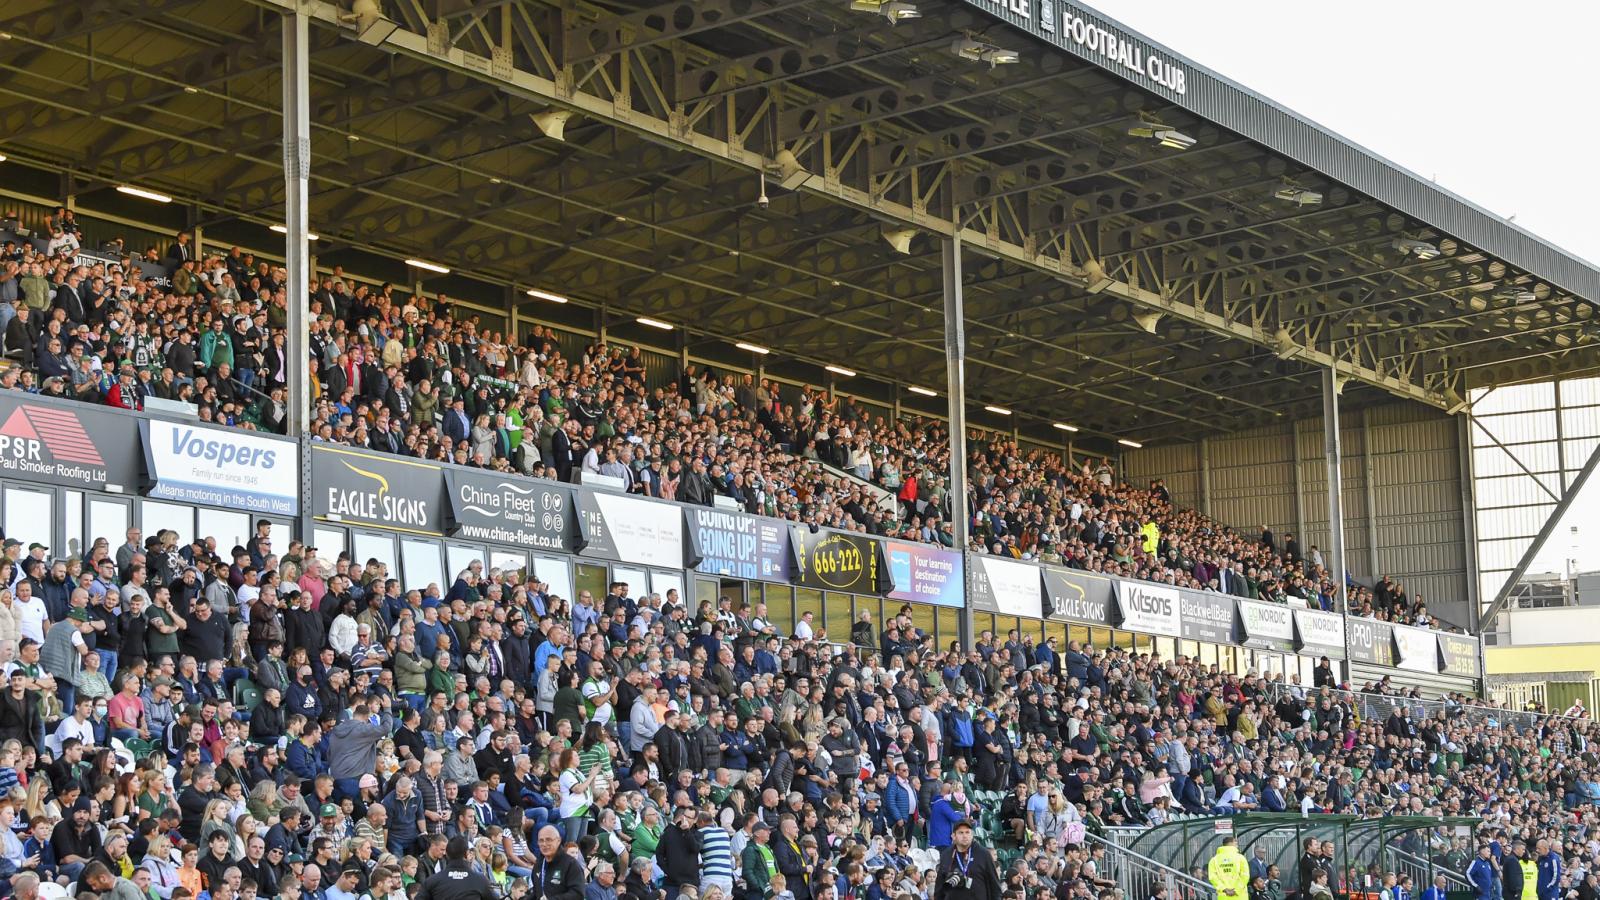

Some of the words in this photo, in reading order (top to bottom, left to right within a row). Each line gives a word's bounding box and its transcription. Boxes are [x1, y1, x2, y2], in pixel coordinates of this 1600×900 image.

[1062, 11, 1145, 76] FOOTBALL
[1147, 55, 1186, 95] CLUB
[0, 434, 41, 461] PSR
[172, 427, 276, 469] Vospers
[20, 459, 55, 475] Smoker
[57, 464, 91, 482] Roofing
[93, 469, 107, 482] Ltd
[192, 467, 212, 480] Family
[225, 473, 242, 483] since
[244, 475, 258, 485] 1946
[157, 483, 185, 497] Means
[186, 488, 222, 504] motoring
[223, 492, 231, 503] in
[232, 493, 245, 505] the
[246, 495, 270, 509] South
[271, 499, 291, 512] West
[329, 487, 377, 519] EAGLE
[383, 495, 427, 526] SIGNS
[461, 484, 500, 507] China
[504, 491, 536, 512] Fleet
[504, 510, 524, 523] Country
[524, 512, 536, 523] Club
[462, 524, 564, 549] www.china-fleet.co.uk
[698, 527, 736, 559] GOING
[737, 533, 757, 562] UP!
[815, 548, 861, 574] 666-222
[914, 555, 929, 568] Your
[929, 557, 953, 574] learning
[914, 569, 947, 584] destination
[915, 582, 922, 593] of
[922, 583, 941, 596] choice
[1055, 596, 1080, 618] EAGLE
[1082, 600, 1105, 622] SIGNS
[1128, 587, 1172, 616] Kitsons
[1180, 598, 1232, 622] BlackwellBate
[1258, 609, 1286, 625] NORDIC
[1312, 617, 1338, 633] NORDIC
